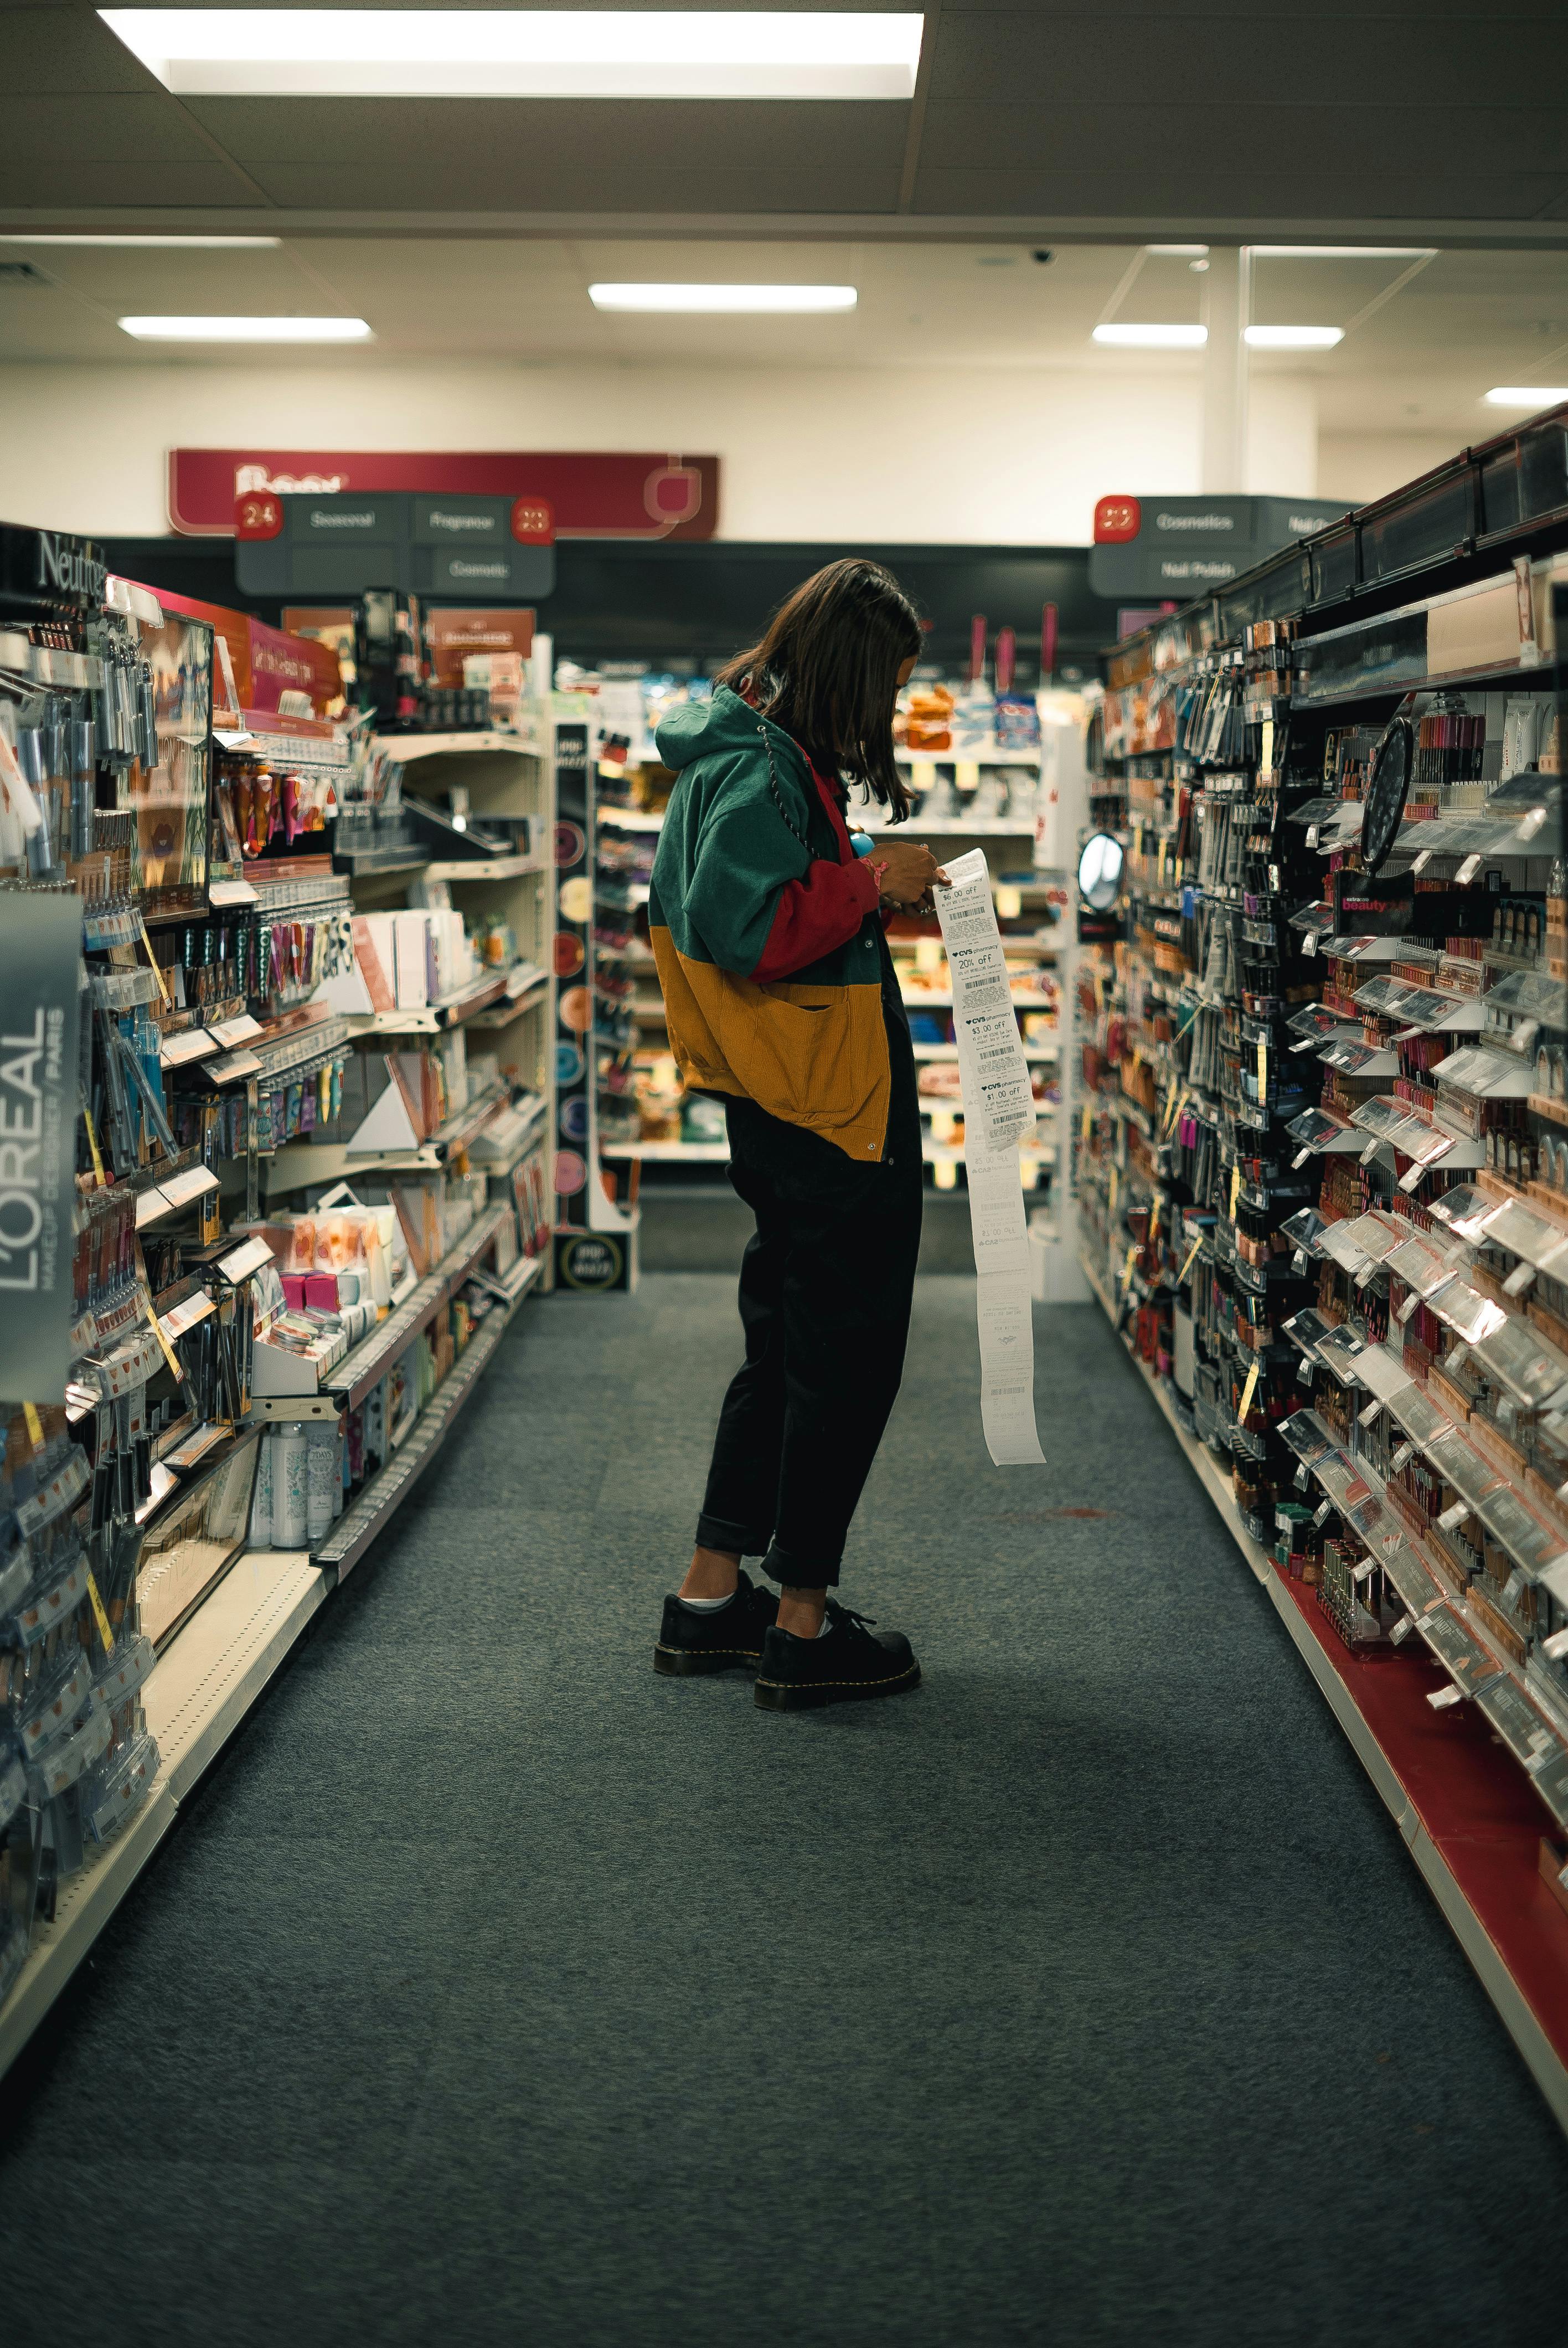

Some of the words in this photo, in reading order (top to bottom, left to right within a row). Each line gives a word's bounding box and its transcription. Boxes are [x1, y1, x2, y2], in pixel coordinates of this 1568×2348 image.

[1156, 513, 1234, 530] Cosmetics
[1162, 561, 1189, 578] Nail
[943, 890, 962, 900] $6.00
[966, 886, 977, 895] off
[973, 944, 998, 954] pharmacy
[959, 959, 974, 969] 20%
[978, 954, 991, 964] off
[986, 1012, 1010, 1021] pharmacy
[972, 1024, 991, 1034] $3.00
[994, 1021, 1005, 1029] off
[1002, 1078, 1026, 1088] pharmacy
[987, 1090, 1007, 1100] $1.00
[1009, 1087, 1020, 1095] off
[0, 1007, 44, 1290] L'OREAL
[42, 1206, 56, 1291] MAKEUP
